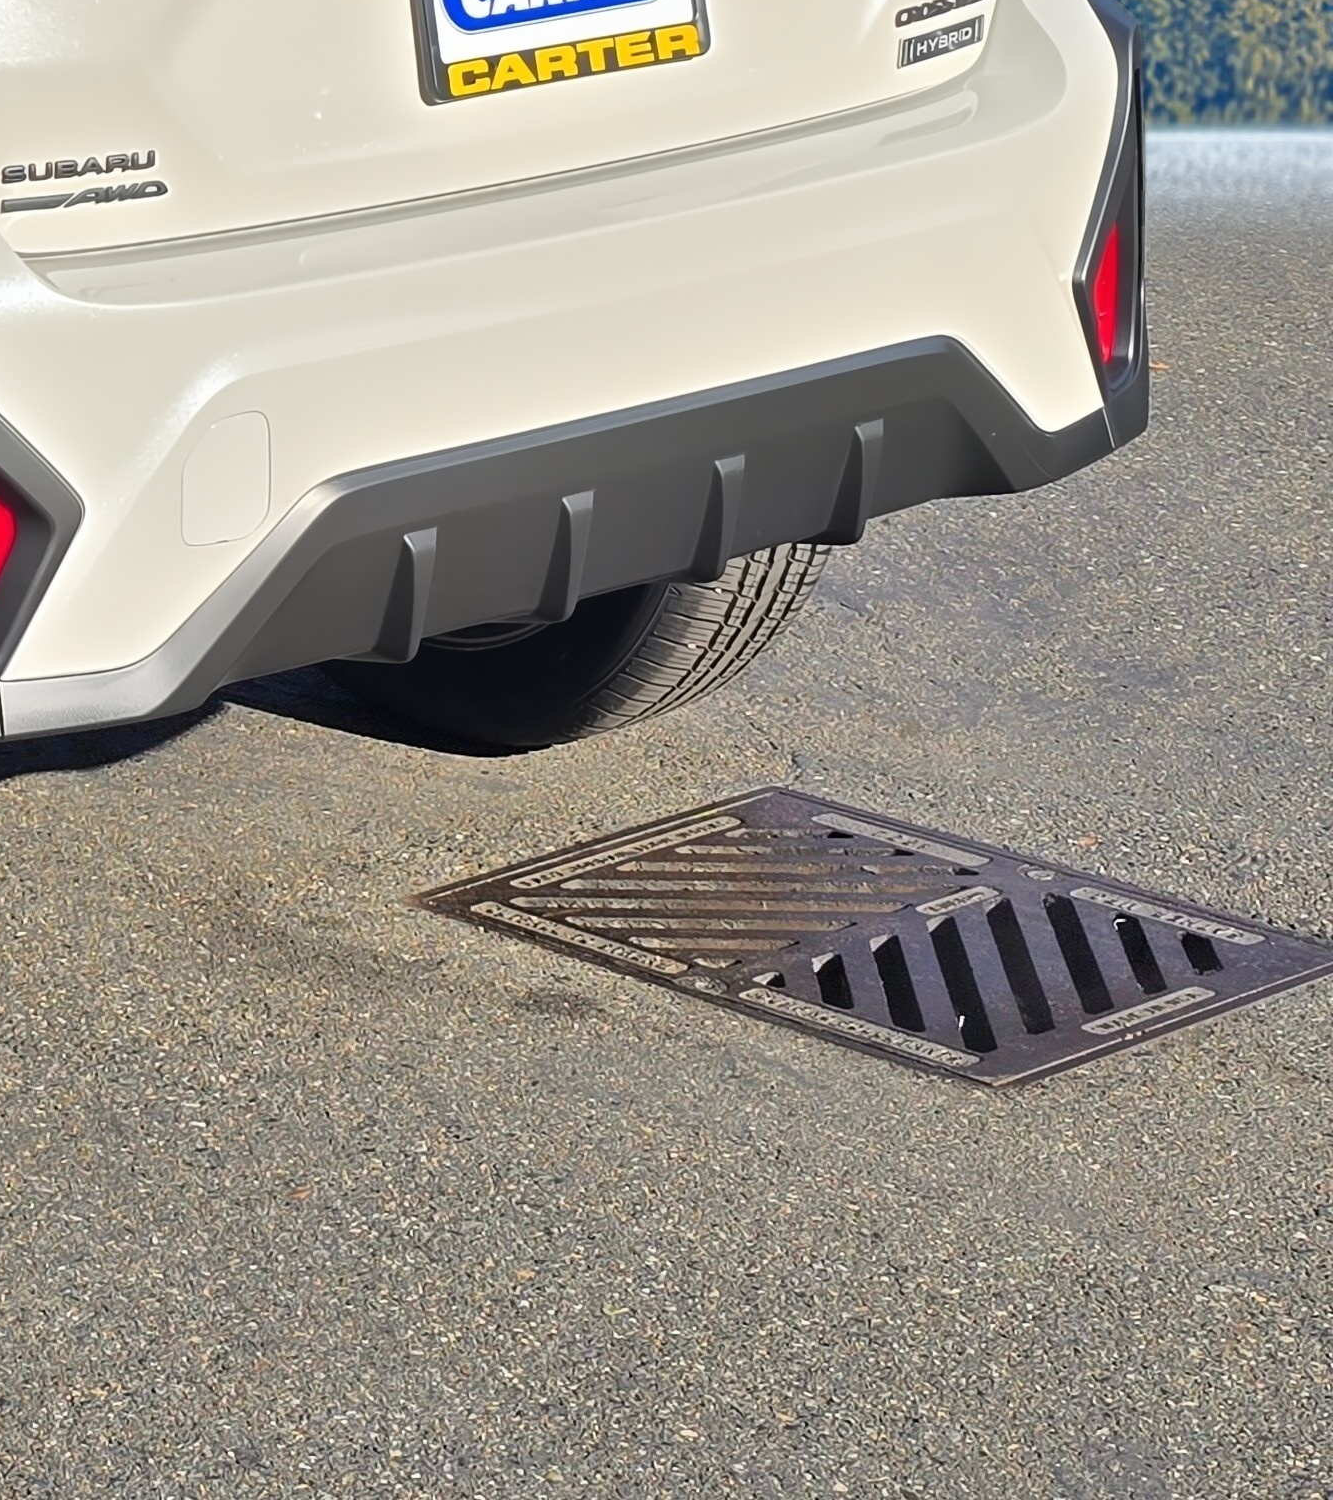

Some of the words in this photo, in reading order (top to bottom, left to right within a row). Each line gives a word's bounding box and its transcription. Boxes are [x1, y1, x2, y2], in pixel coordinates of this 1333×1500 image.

[916, 26, 973, 57] HYBRID
[447, 24, 700, 97] CARTER
[1, 150, 156, 184] SUBARU
[62, 180, 169, 208] AWD
